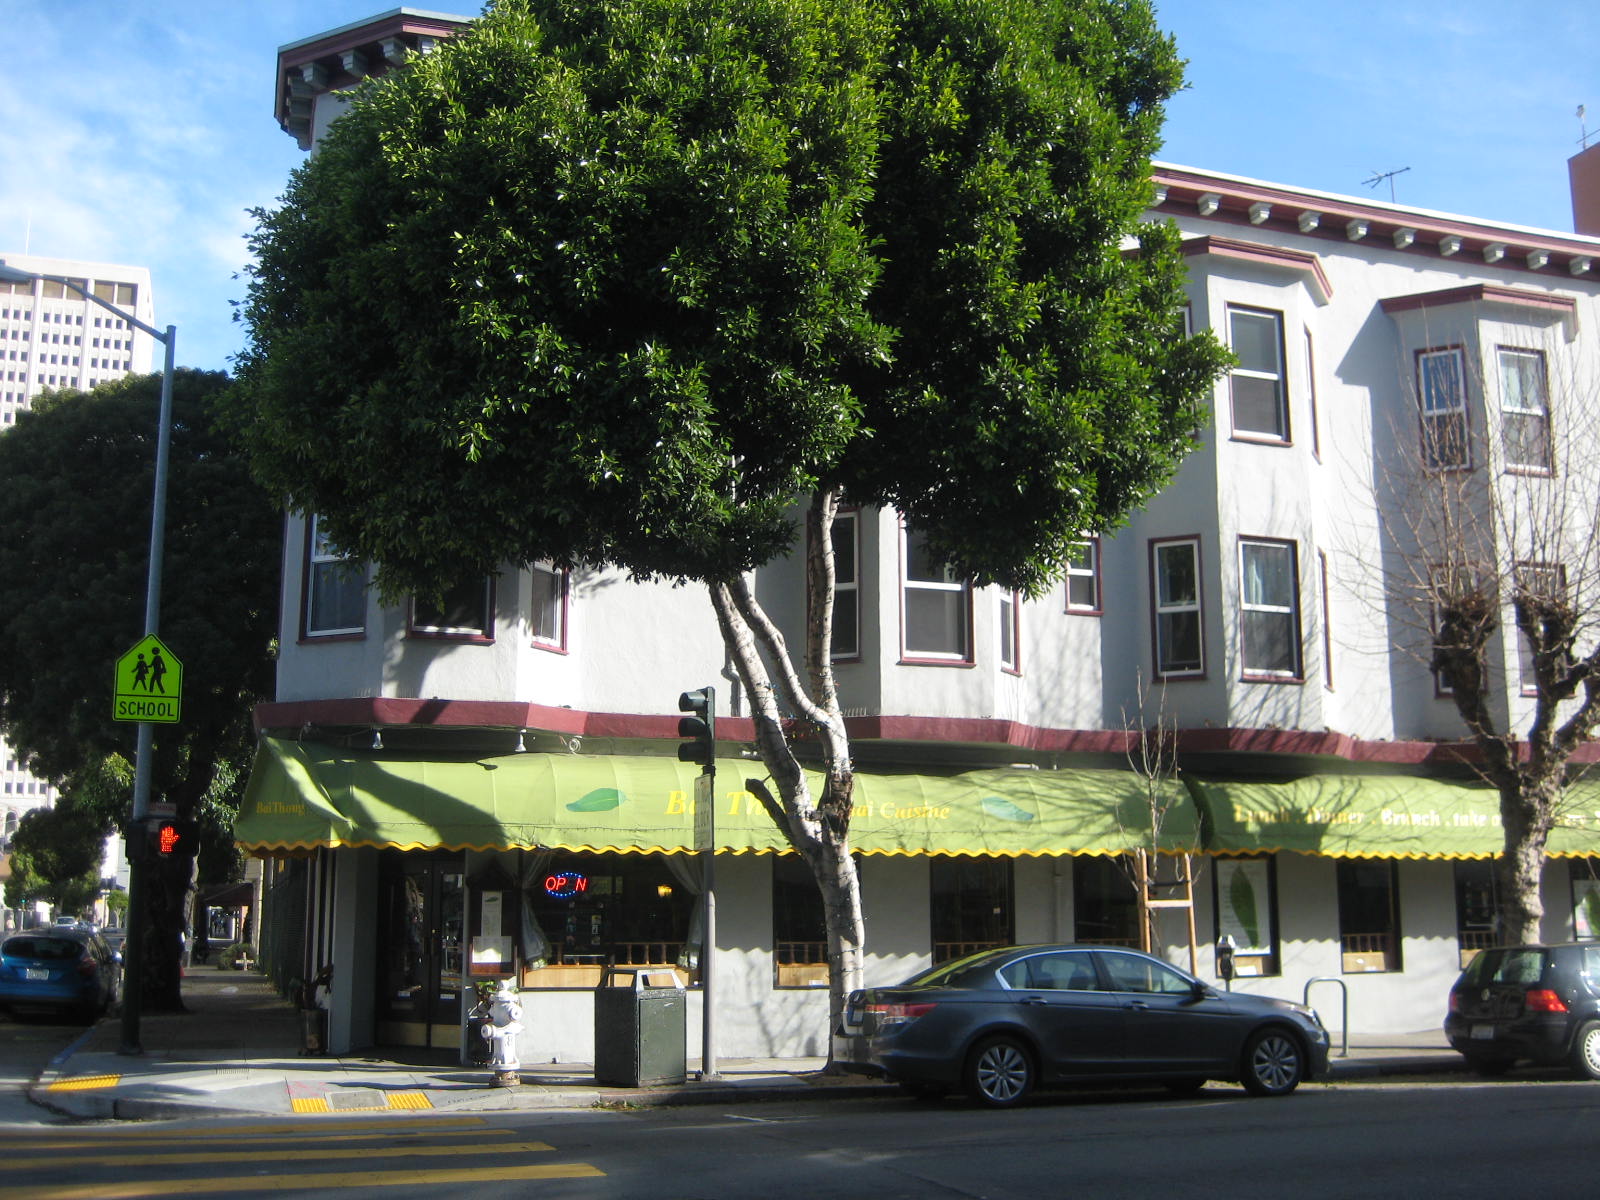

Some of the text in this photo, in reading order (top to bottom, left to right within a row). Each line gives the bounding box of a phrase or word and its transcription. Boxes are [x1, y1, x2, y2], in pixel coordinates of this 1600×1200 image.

[118, 701, 175, 717] SCHOOL
[879, 802, 950, 819] Cuisine
[1380, 808, 1441, 826] Brunch
[545, 876, 588, 892] OPN
